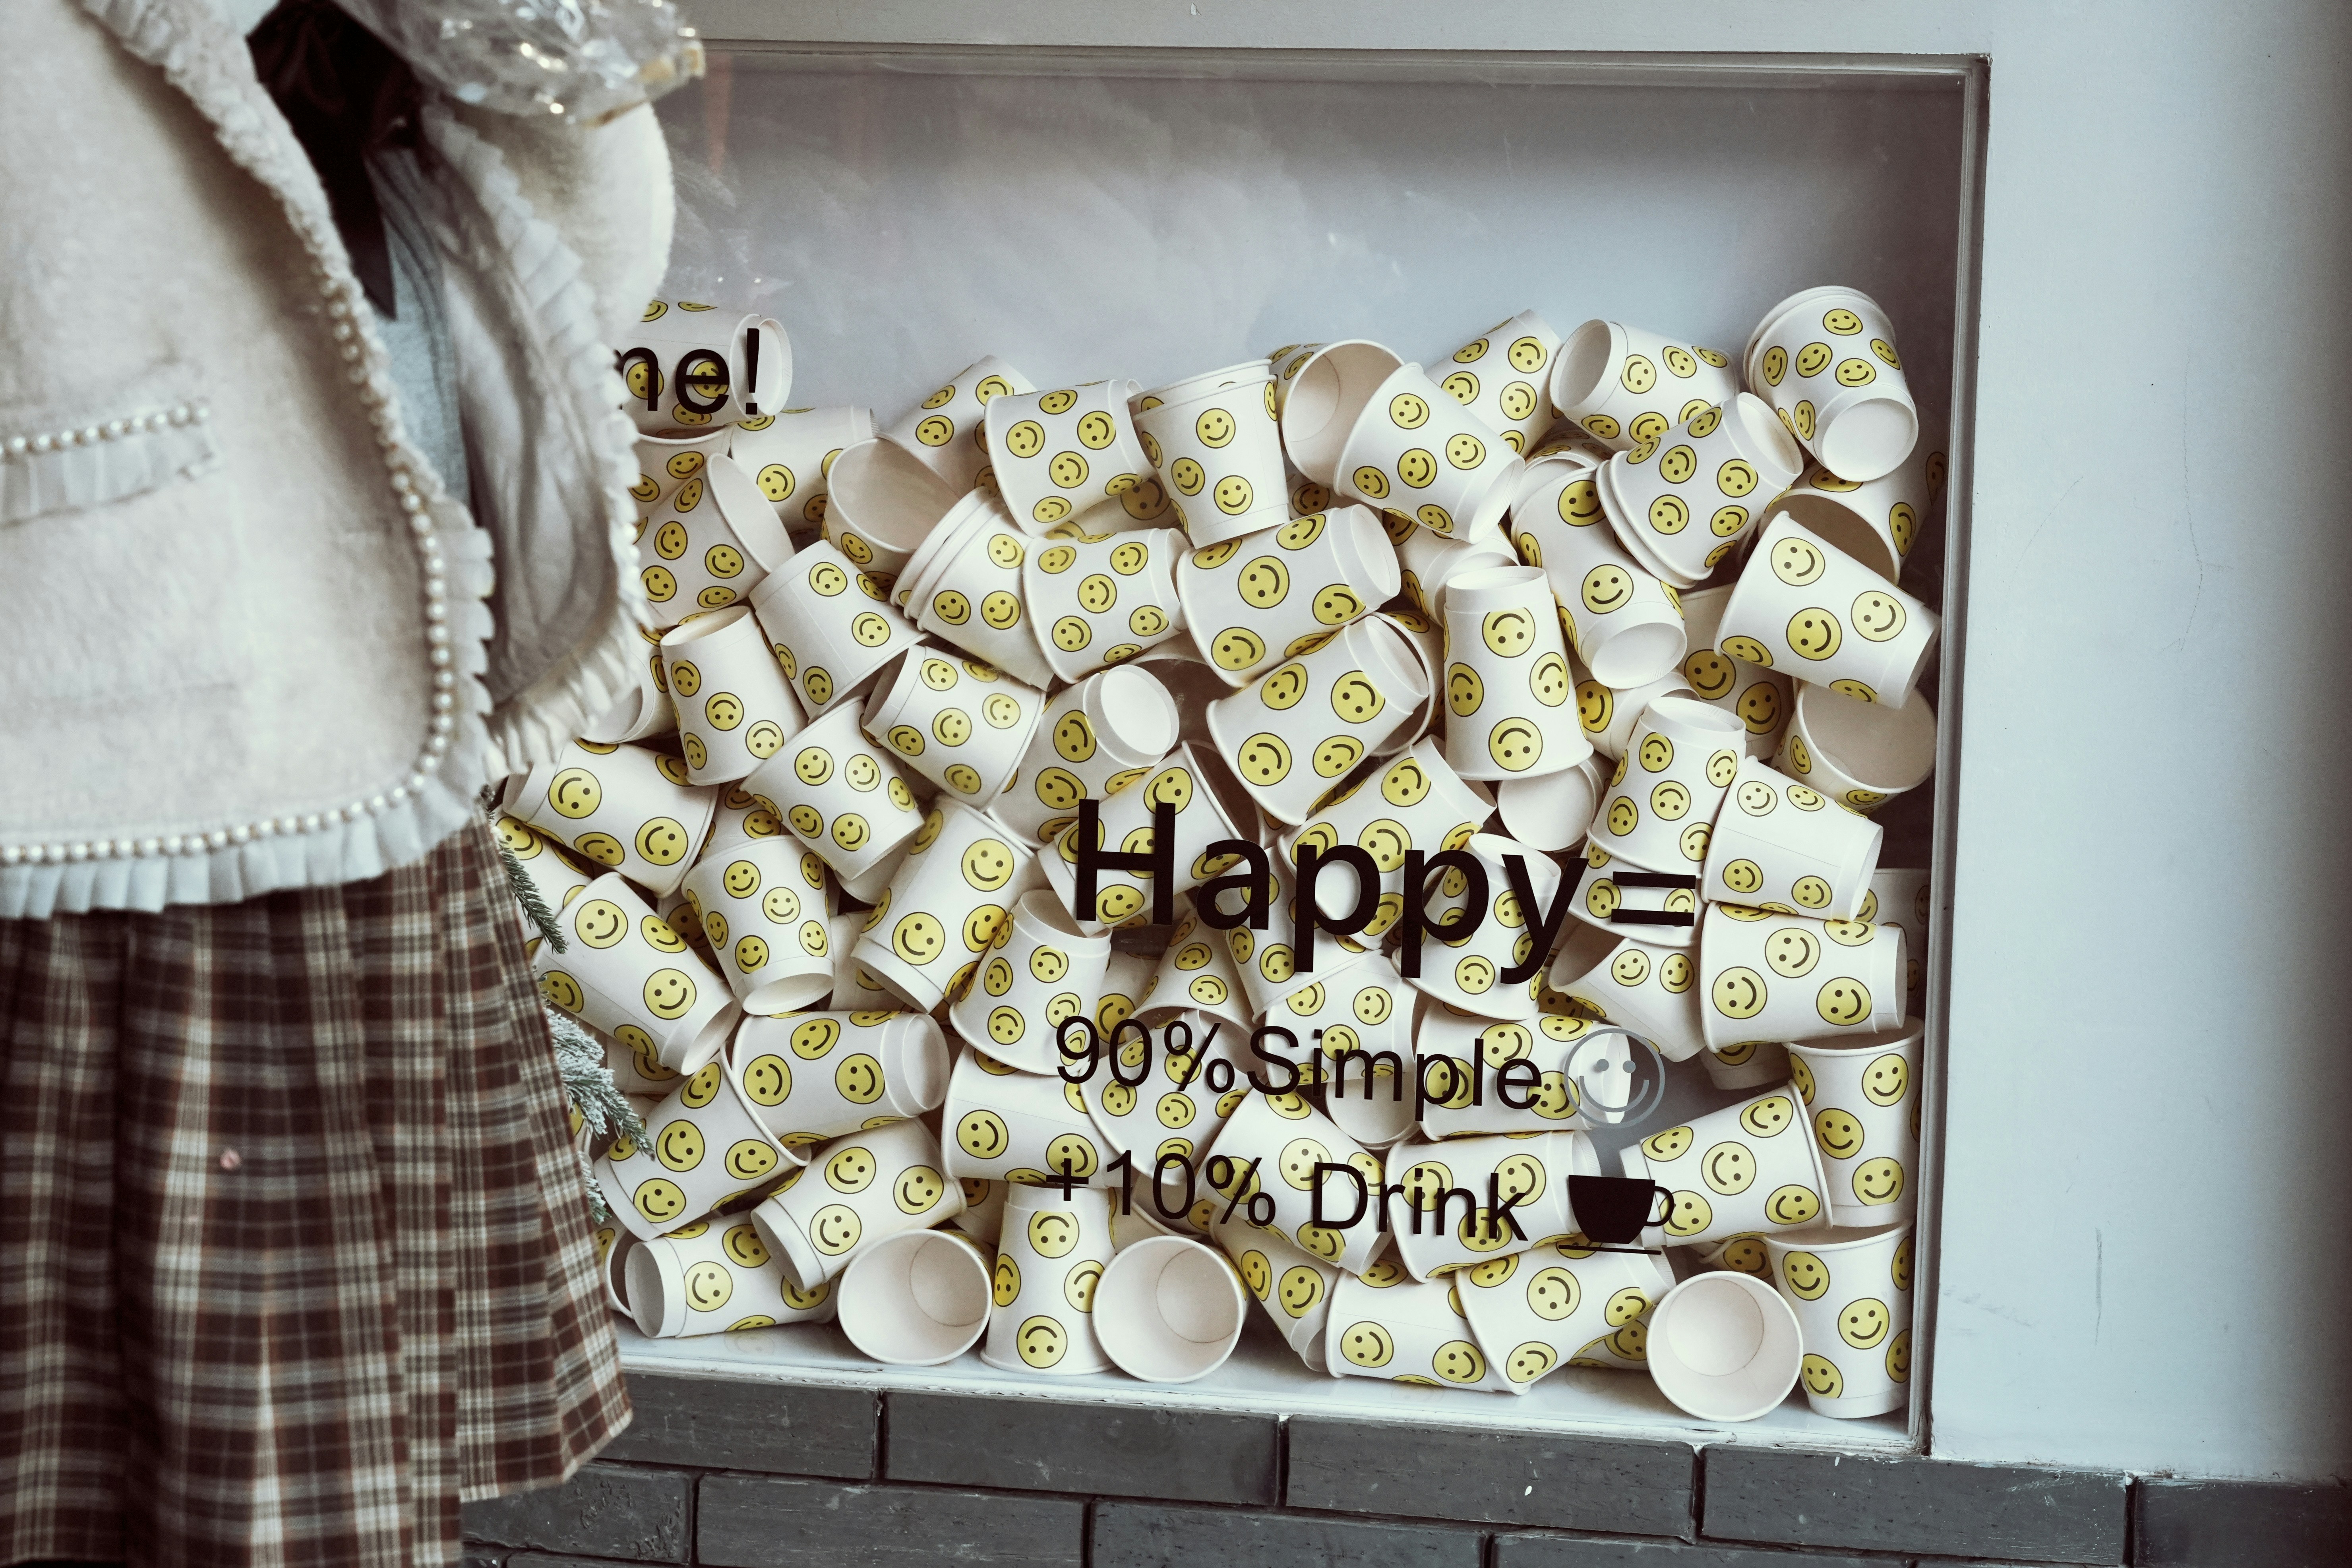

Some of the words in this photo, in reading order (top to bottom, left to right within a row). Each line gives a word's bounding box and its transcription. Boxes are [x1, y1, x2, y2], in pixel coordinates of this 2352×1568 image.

[1076, 799, 1696, 984] Happy=
[1045, 1150, 1276, 1227] +10%
[1311, 1161, 1528, 1241] Drink
